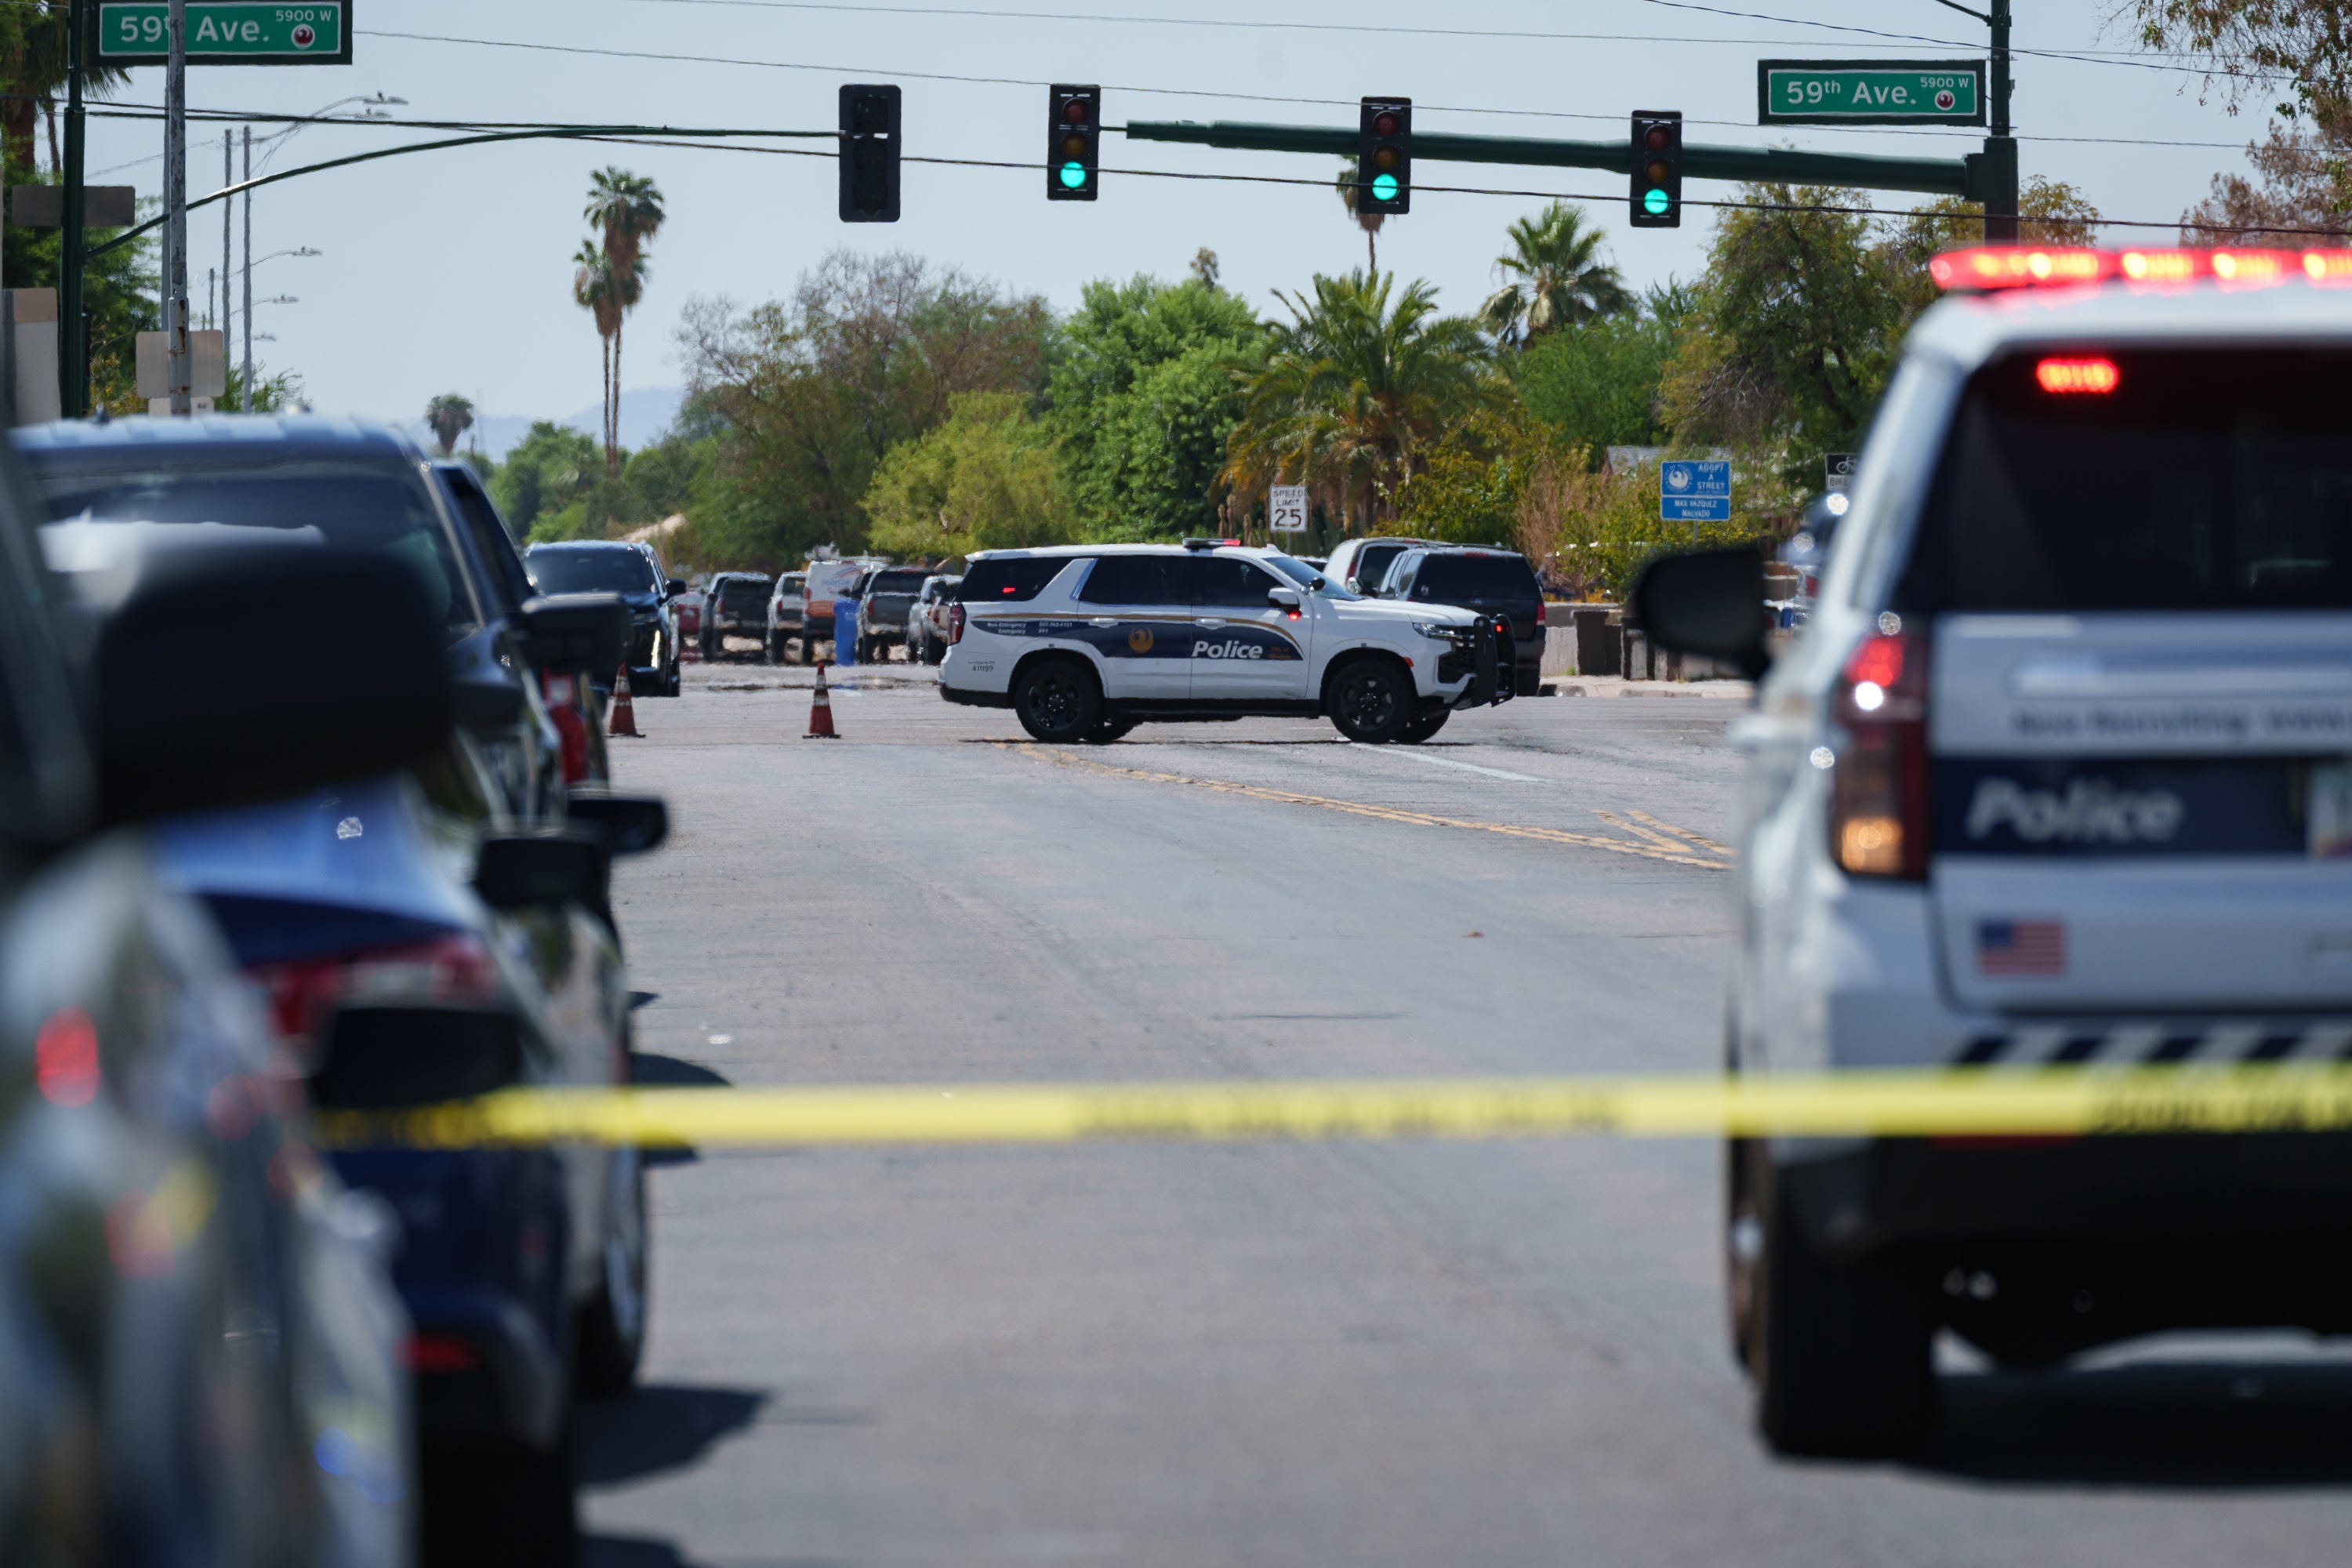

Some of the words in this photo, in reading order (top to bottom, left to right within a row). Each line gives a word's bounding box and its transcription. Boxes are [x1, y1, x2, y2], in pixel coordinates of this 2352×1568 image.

[275, 9, 314, 22] 5900
[320, 10, 332, 22] W
[120, 15, 169, 42] 59t
[196, 16, 270, 42] Ave.
[1921, 77, 1954, 88] 5900
[1958, 78, 1969, 88] W
[1787, 81, 1841, 104] 59th
[1851, 81, 1916, 104] Ave.
[1698, 463, 1724, 473] ADOPT
[1275, 508, 1301, 527] 25
[1191, 640, 1263, 659] Police
[1966, 776, 2184, 844] Police
